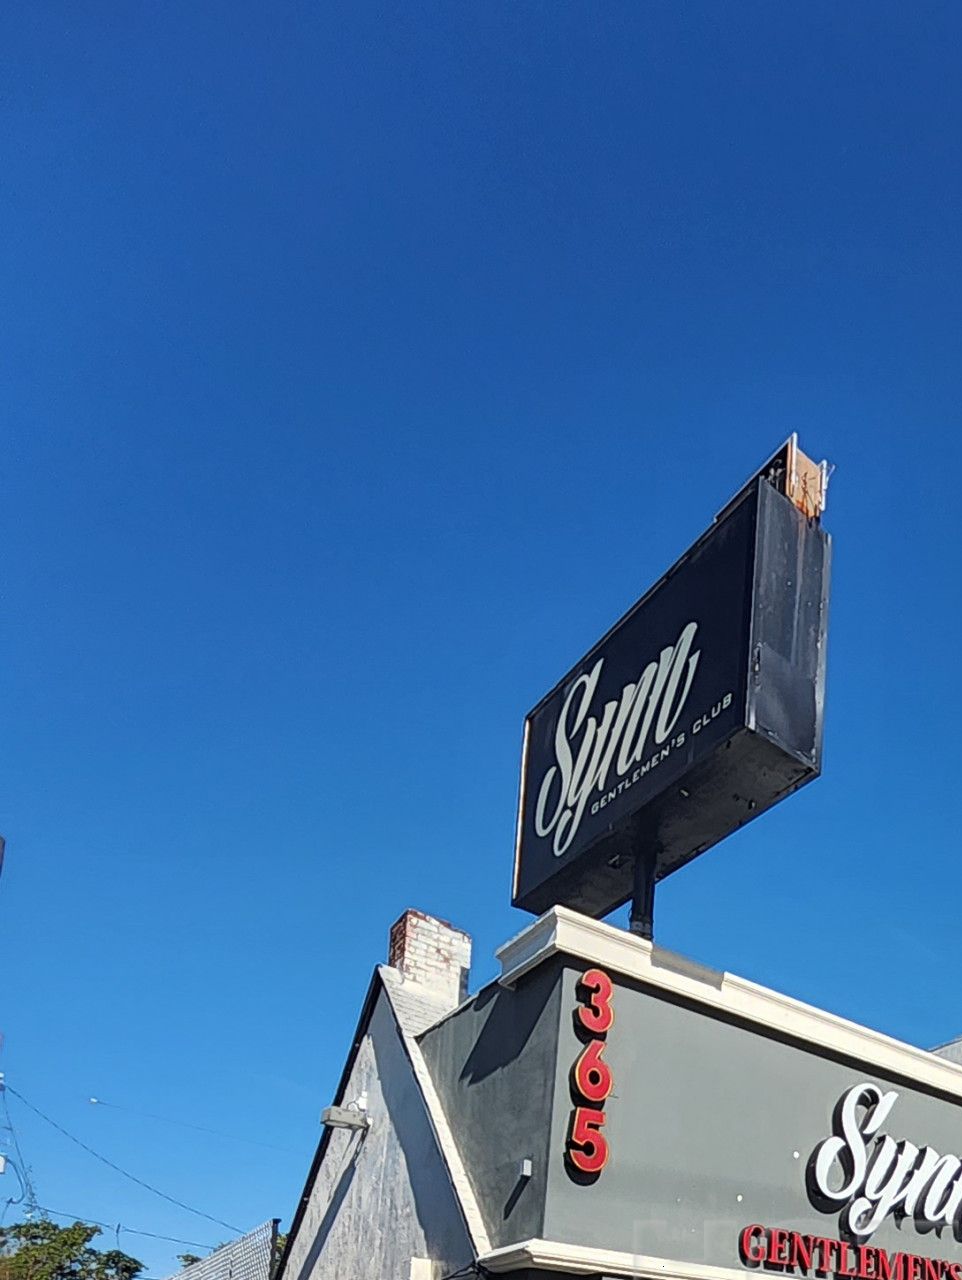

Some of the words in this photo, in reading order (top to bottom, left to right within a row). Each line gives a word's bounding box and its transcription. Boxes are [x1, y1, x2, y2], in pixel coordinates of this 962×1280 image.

[535, 621, 701, 857] Synn
[591, 734, 686, 815] GENTLEMEN'S
[693, 693, 733, 736] CLUB
[570, 968, 614, 1172] 365
